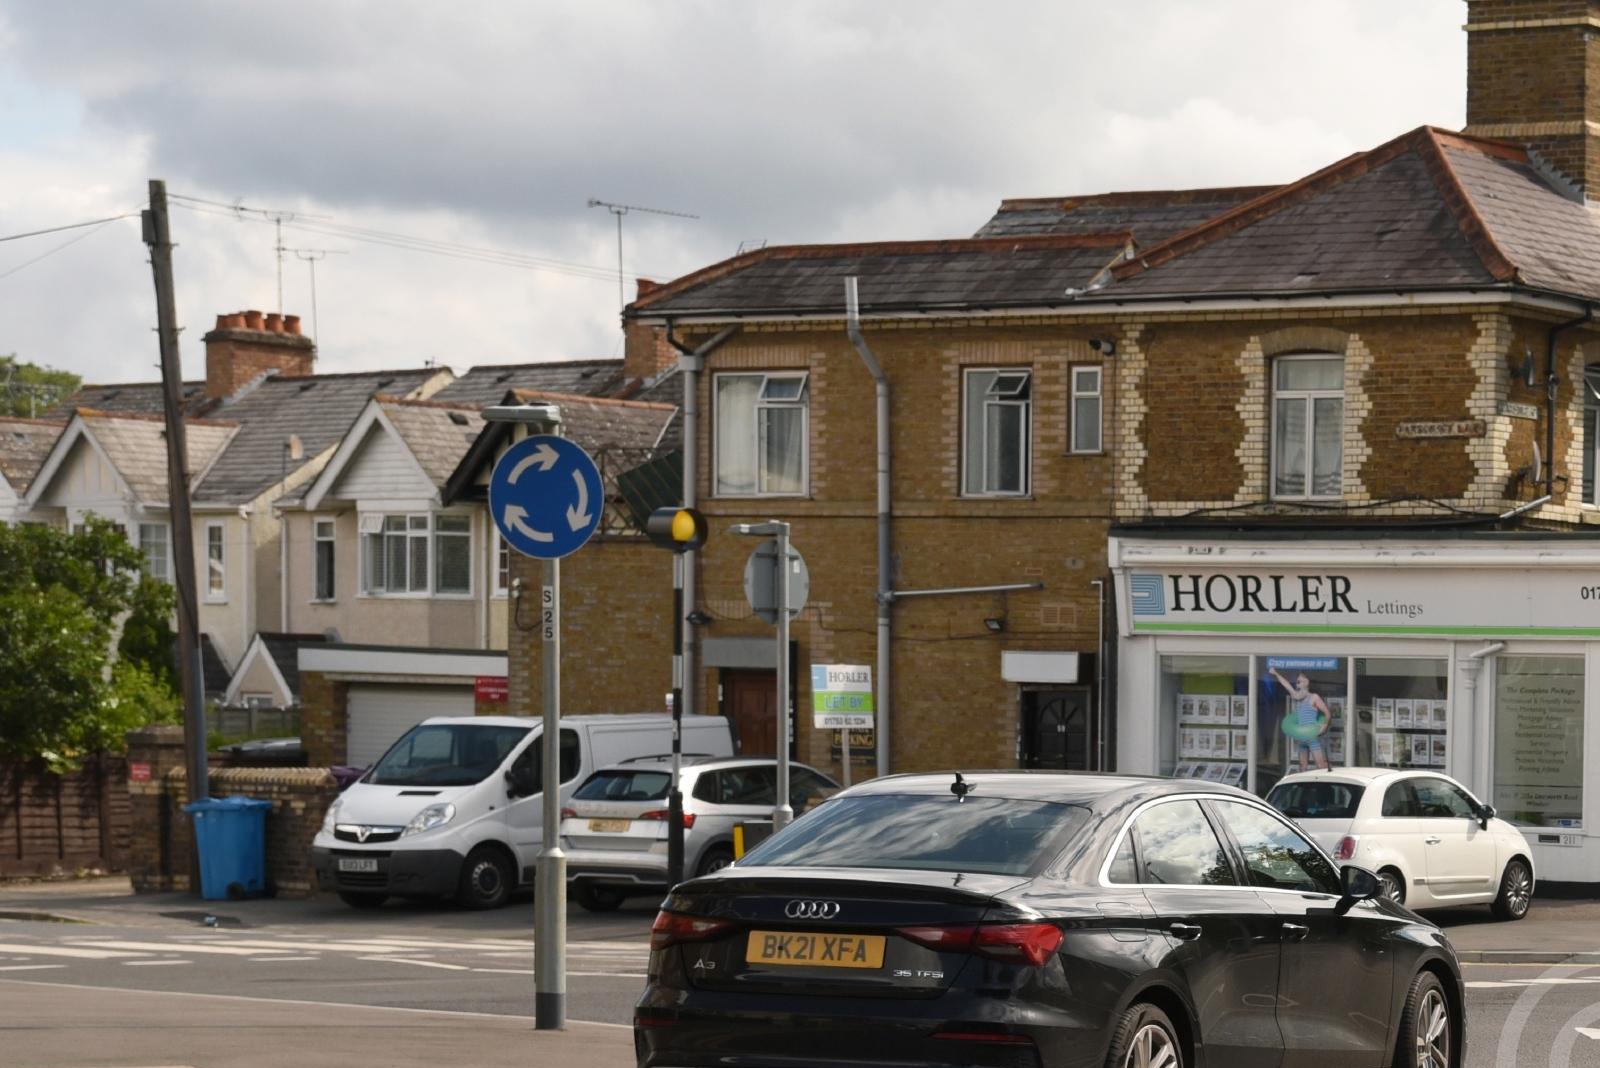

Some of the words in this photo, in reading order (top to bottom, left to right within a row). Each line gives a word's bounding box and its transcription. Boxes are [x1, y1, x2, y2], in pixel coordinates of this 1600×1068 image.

[1168, 573, 1359, 613] HORLER
[1367, 599, 1424, 618] Lettings
[828, 671, 870, 683] HORLER
[824, 695, 845, 708] LET
[1562, 835, 1576, 845] 211
[761, 934, 816, 960] BK21
[822, 936, 867, 962] XFA
[694, 958, 715, 969] A3
[893, 969, 912, 977] 35
